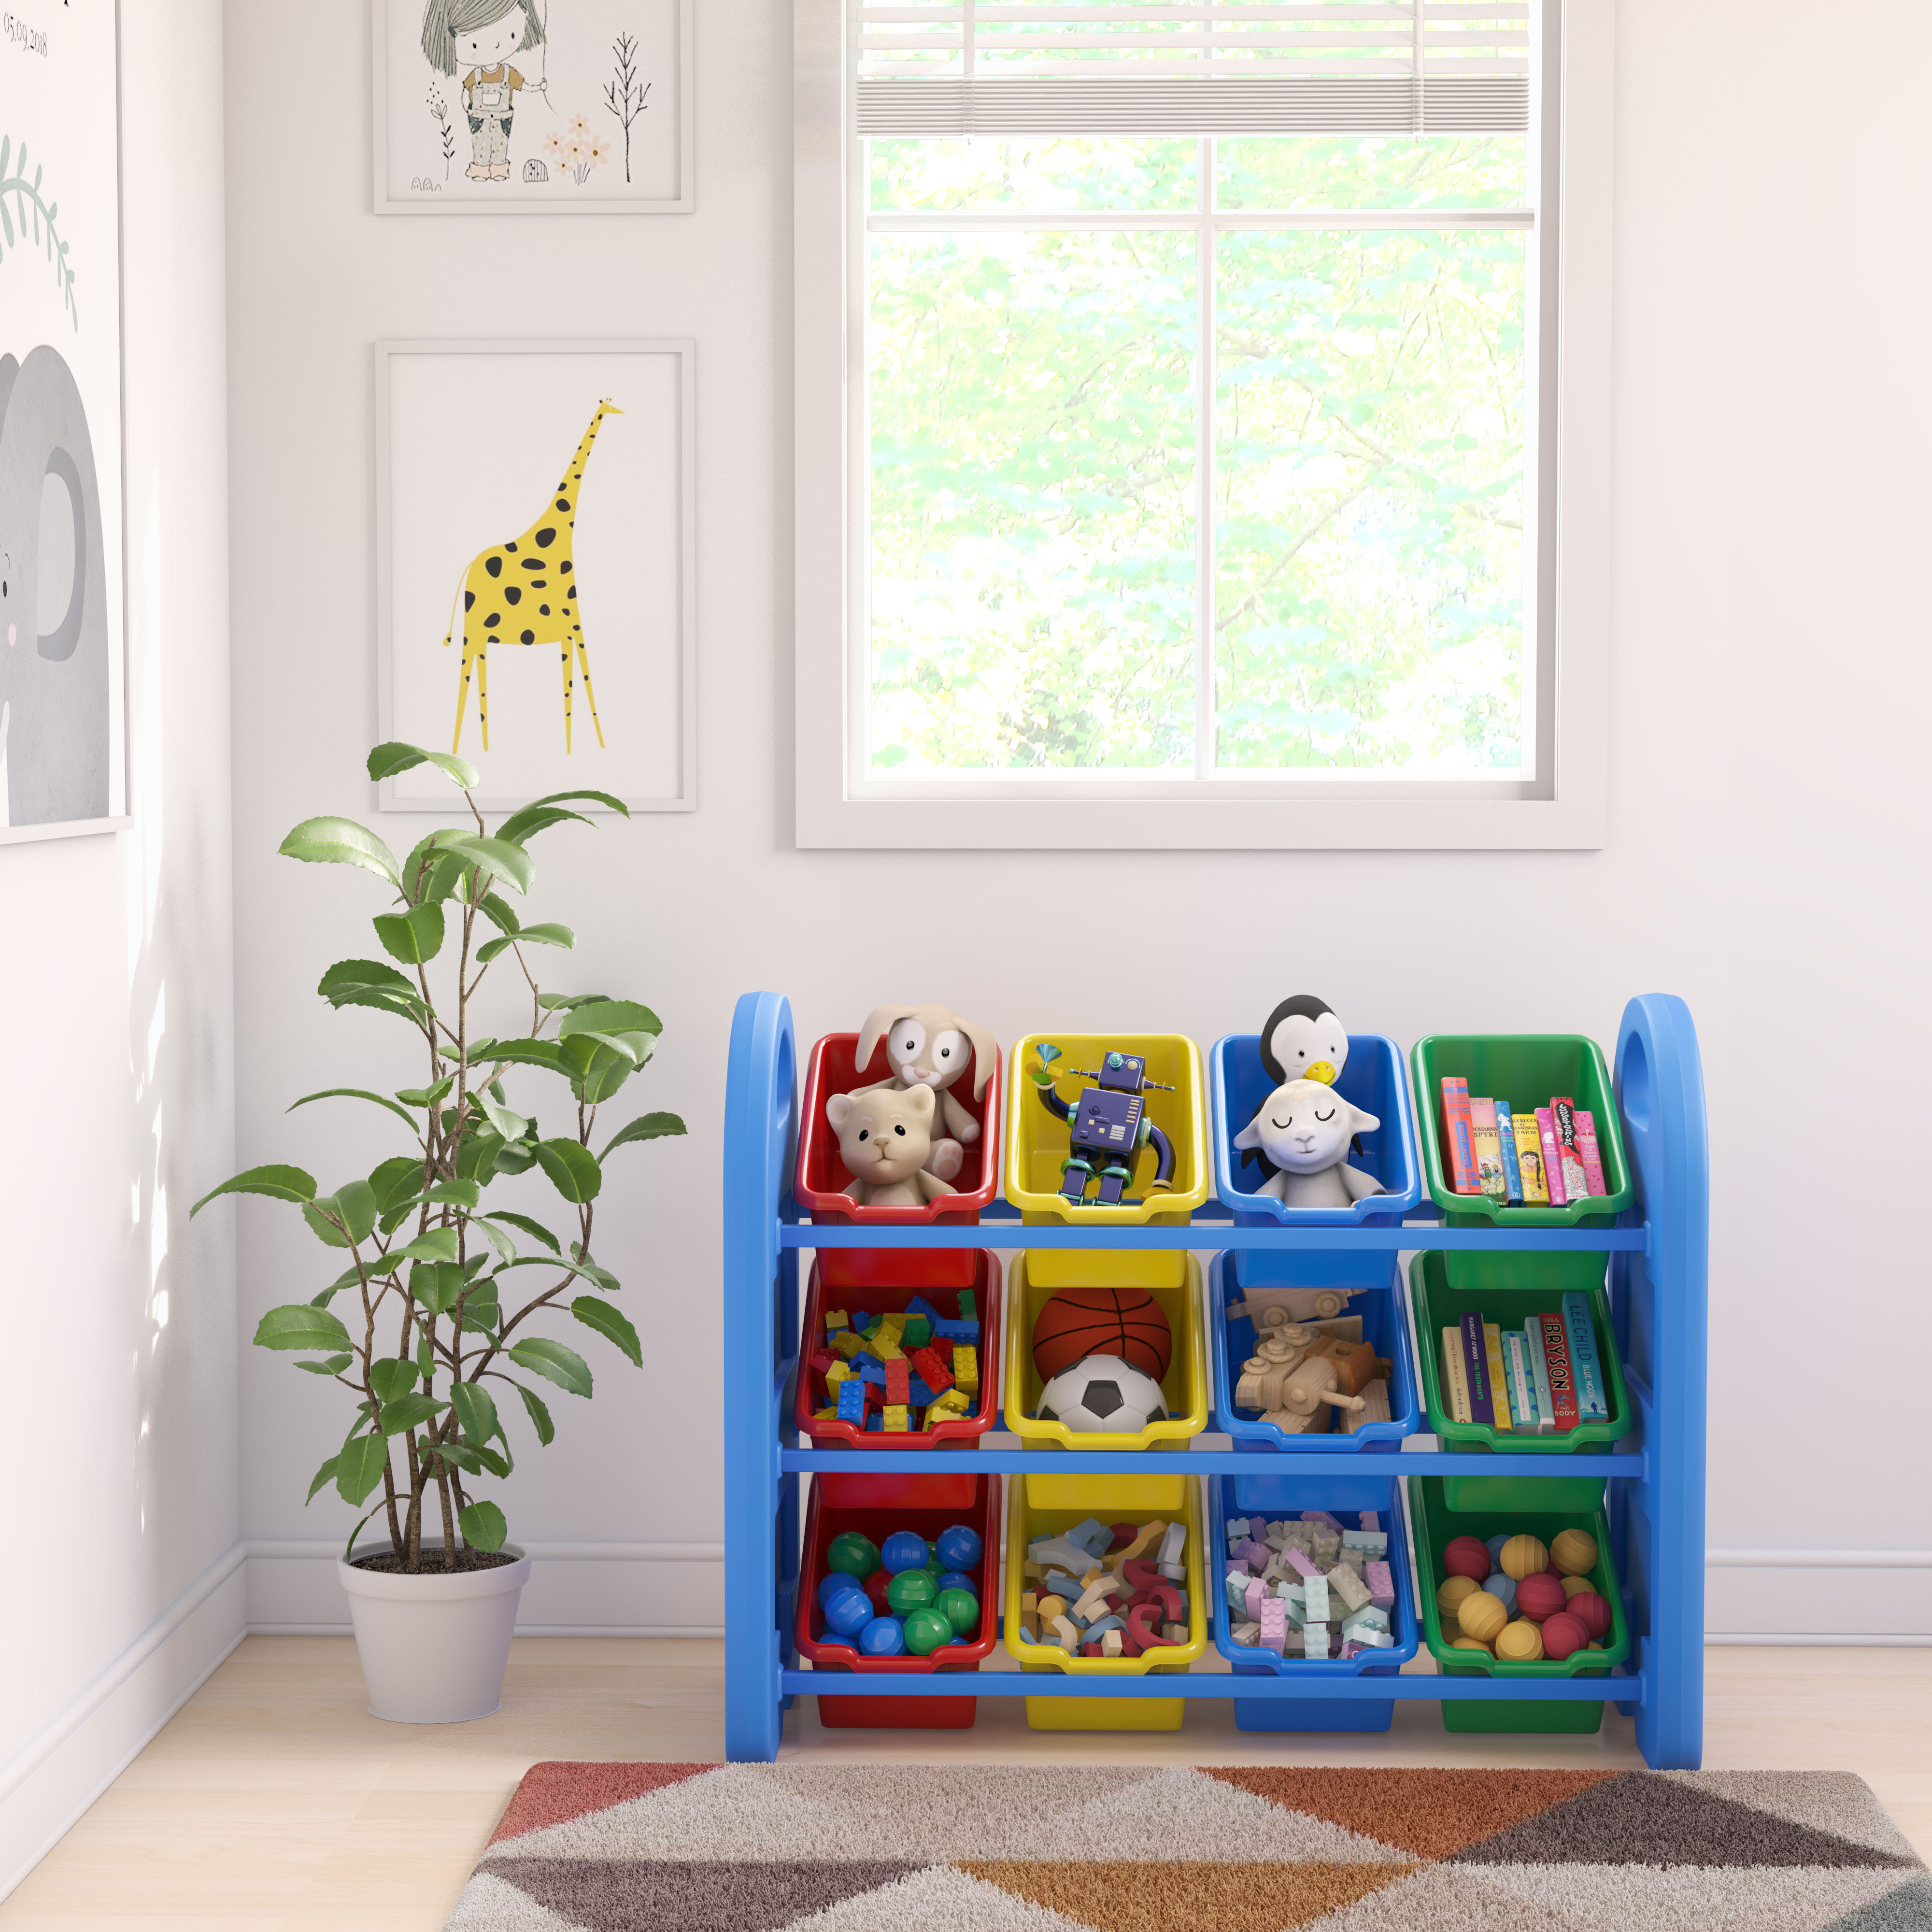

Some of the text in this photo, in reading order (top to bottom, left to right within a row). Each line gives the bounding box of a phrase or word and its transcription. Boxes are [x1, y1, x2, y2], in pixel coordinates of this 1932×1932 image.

[4, 12, 47, 57] 05.09.2018
[1468, 1317, 1476, 1340] MARGARET
[1475, 1372, 1483, 1400] TESTAMENTS
[1544, 1323, 1570, 1390] BRYSON
[1570, 1306, 1596, 1398] LEE CHILD BLUE MOON
